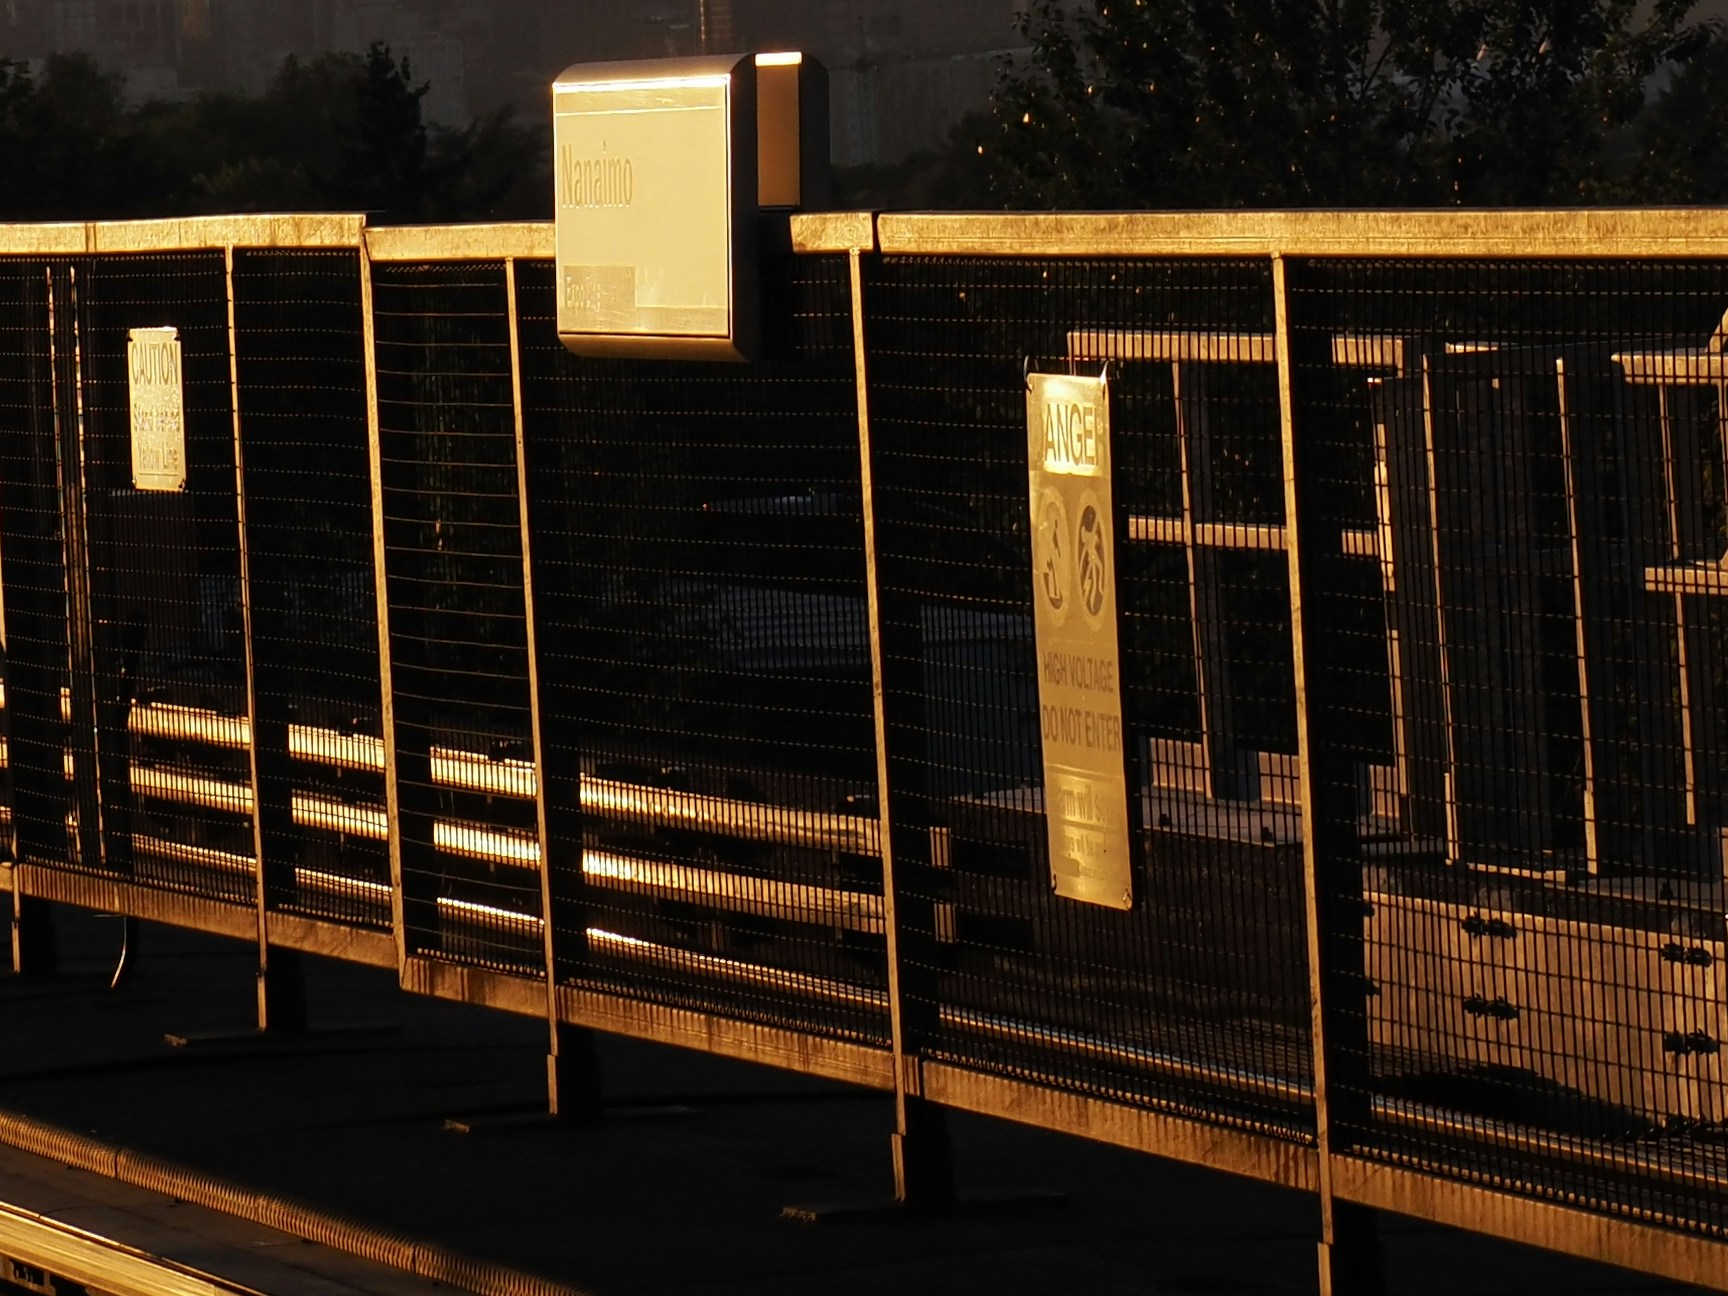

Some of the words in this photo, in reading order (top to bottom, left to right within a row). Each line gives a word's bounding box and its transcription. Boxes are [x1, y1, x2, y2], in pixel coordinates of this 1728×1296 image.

[562, 140, 633, 208] Nanaimo
[131, 342, 178, 385] CAUTION
[1043, 651, 1068, 687] HIGH
[1069, 653, 1114, 693] VOLTAGE
[1042, 704, 1059, 743] DO
[1060, 706, 1082, 746] NOT
[1084, 711, 1121, 752] ENTER
